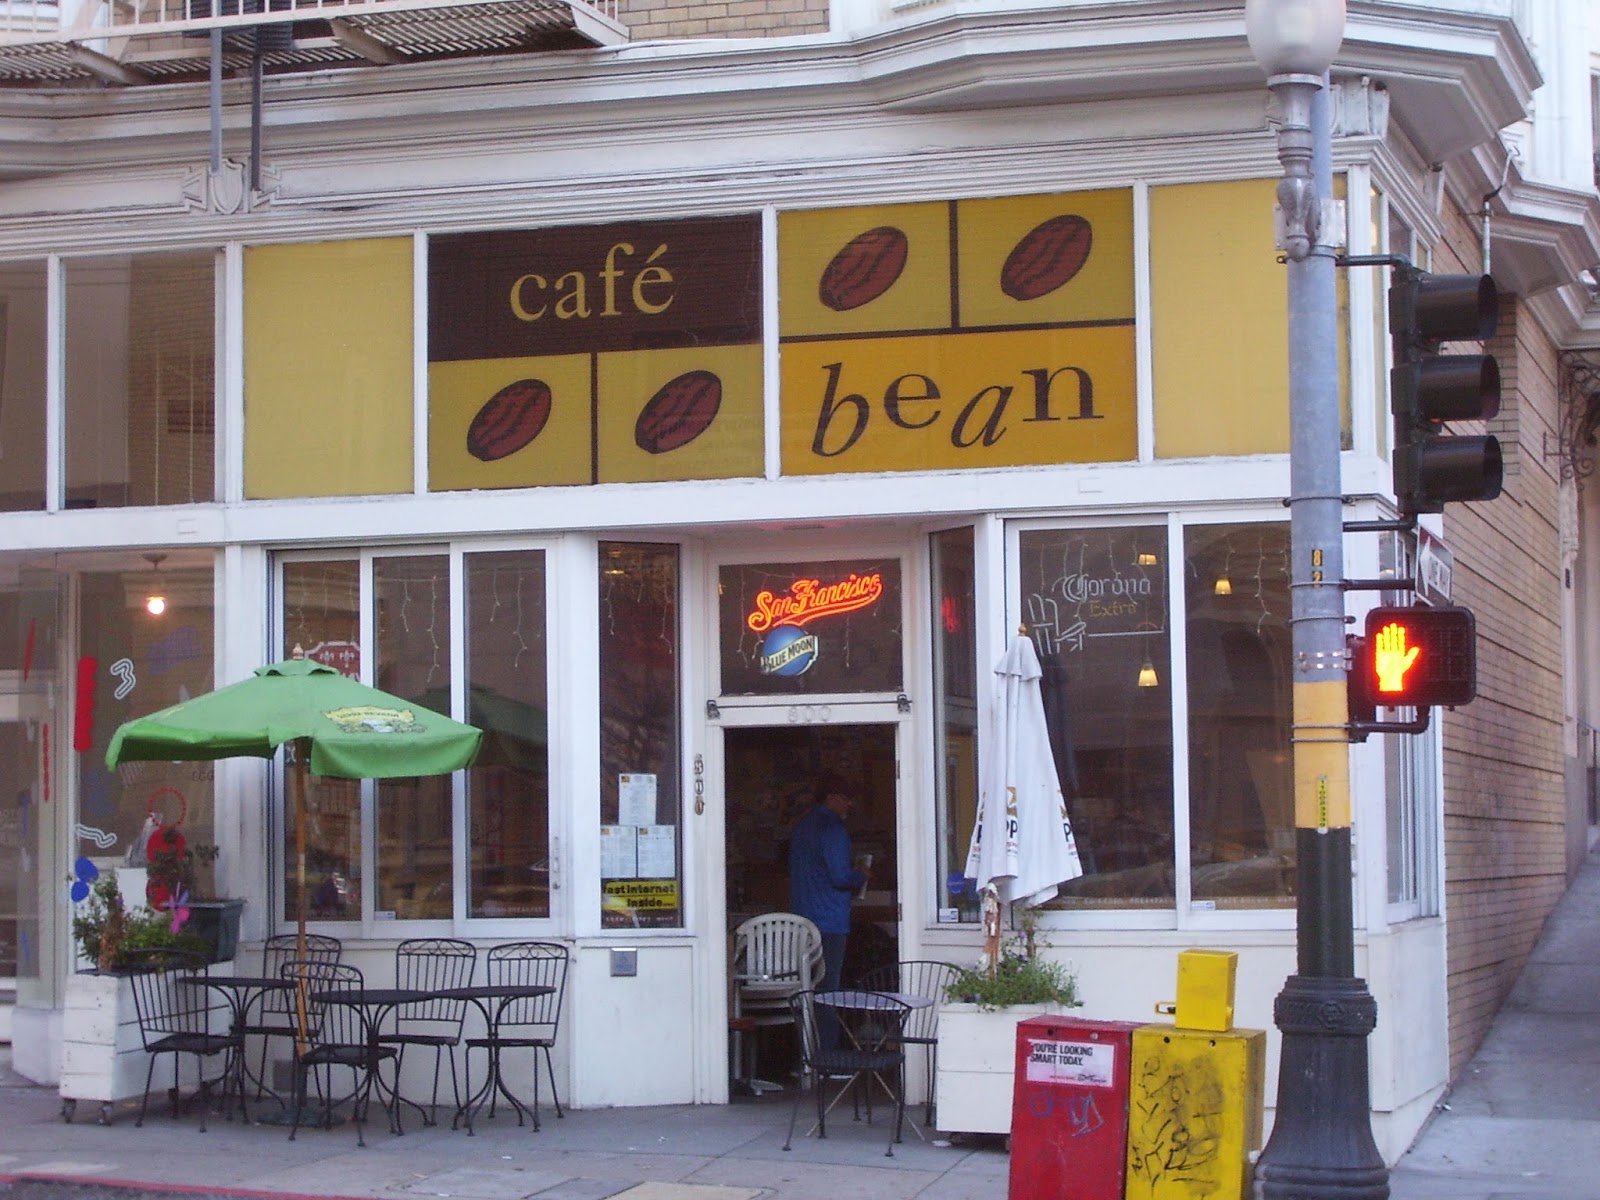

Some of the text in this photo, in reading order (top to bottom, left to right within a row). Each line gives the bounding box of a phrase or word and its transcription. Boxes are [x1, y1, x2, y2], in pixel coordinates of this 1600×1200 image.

[509, 242, 674, 322] café
[811, 361, 1105, 458] bean
[748, 573, 883, 631] San Francisco
[1061, 573, 1151, 602] Corona
[1088, 599, 1137, 618] Extra
[761, 638, 814, 673] BLUE MOON
[1031, 1053, 1056, 1064] SMART
[1060, 1045, 1093, 1056] LOOKING
